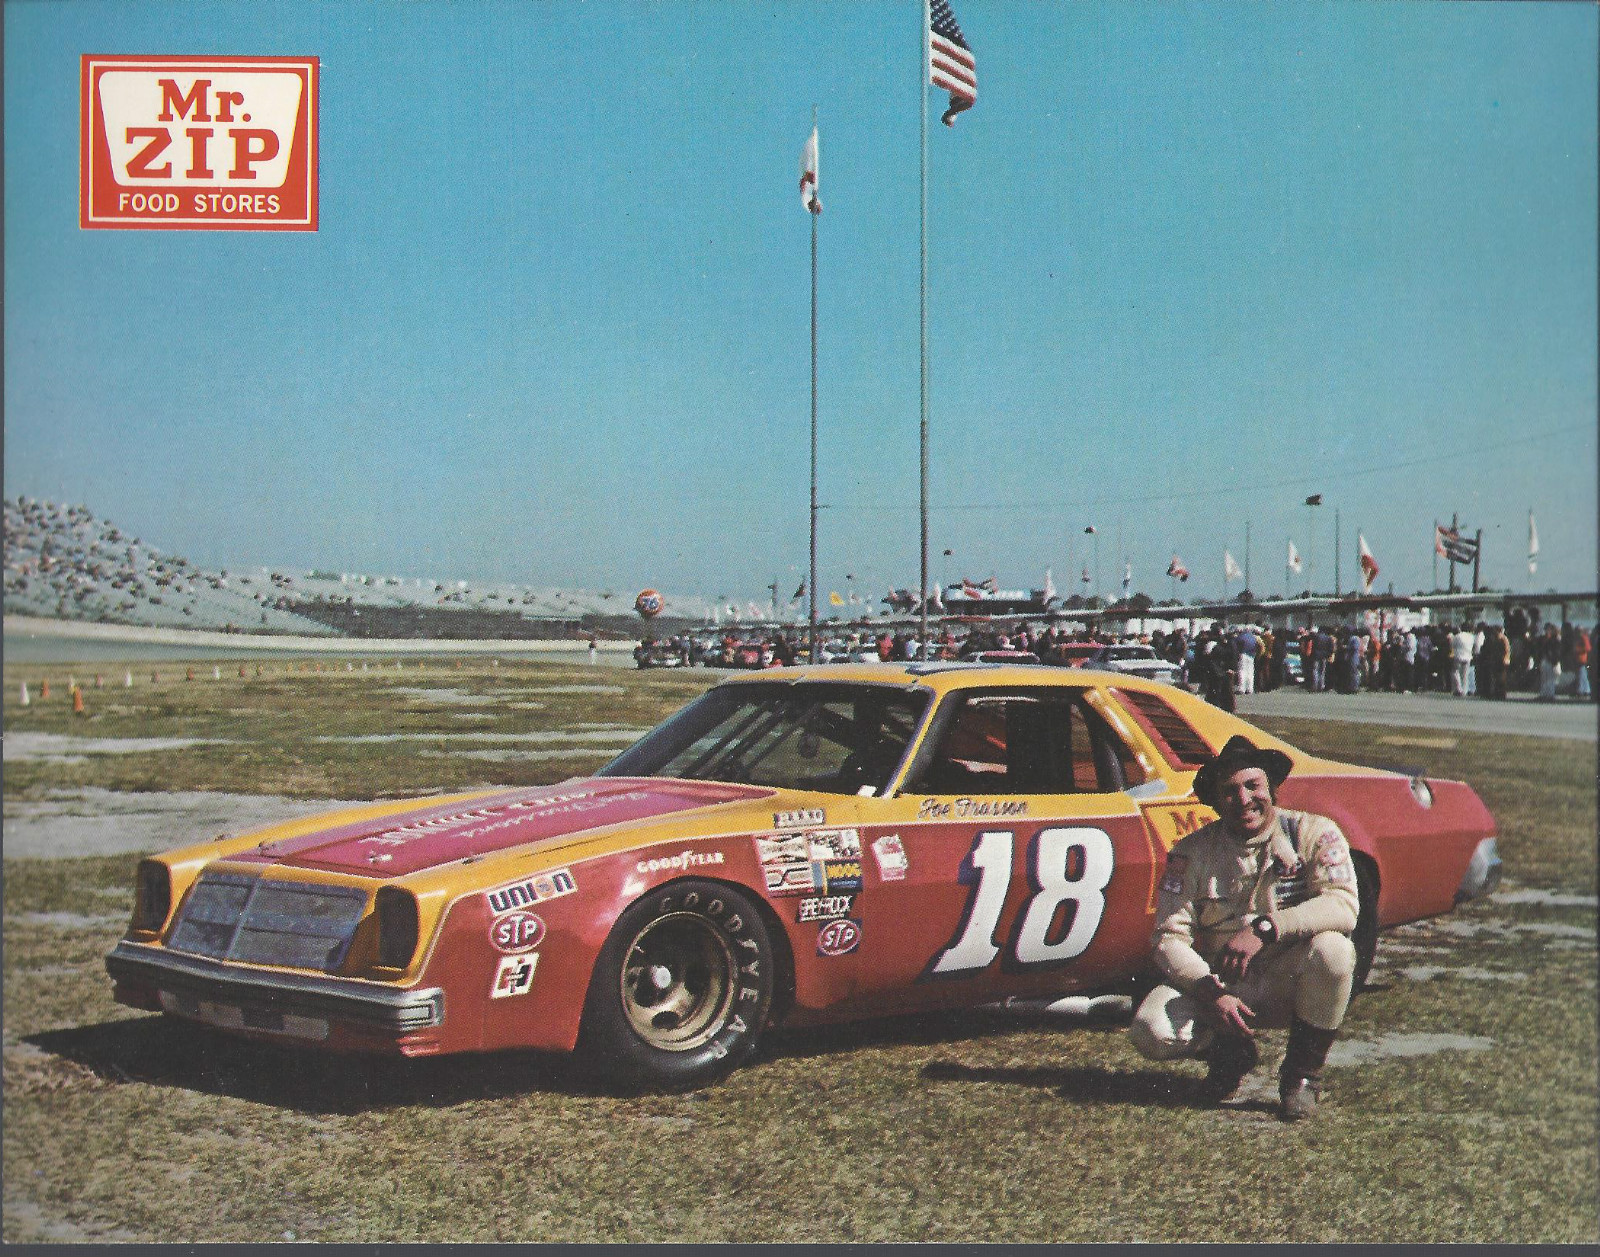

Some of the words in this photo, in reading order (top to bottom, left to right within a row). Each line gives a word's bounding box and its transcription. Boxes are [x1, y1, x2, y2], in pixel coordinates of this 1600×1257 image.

[928, 826, 1115, 974] 18
[499, 914, 537, 944] STP
[825, 923, 855, 947] STP
